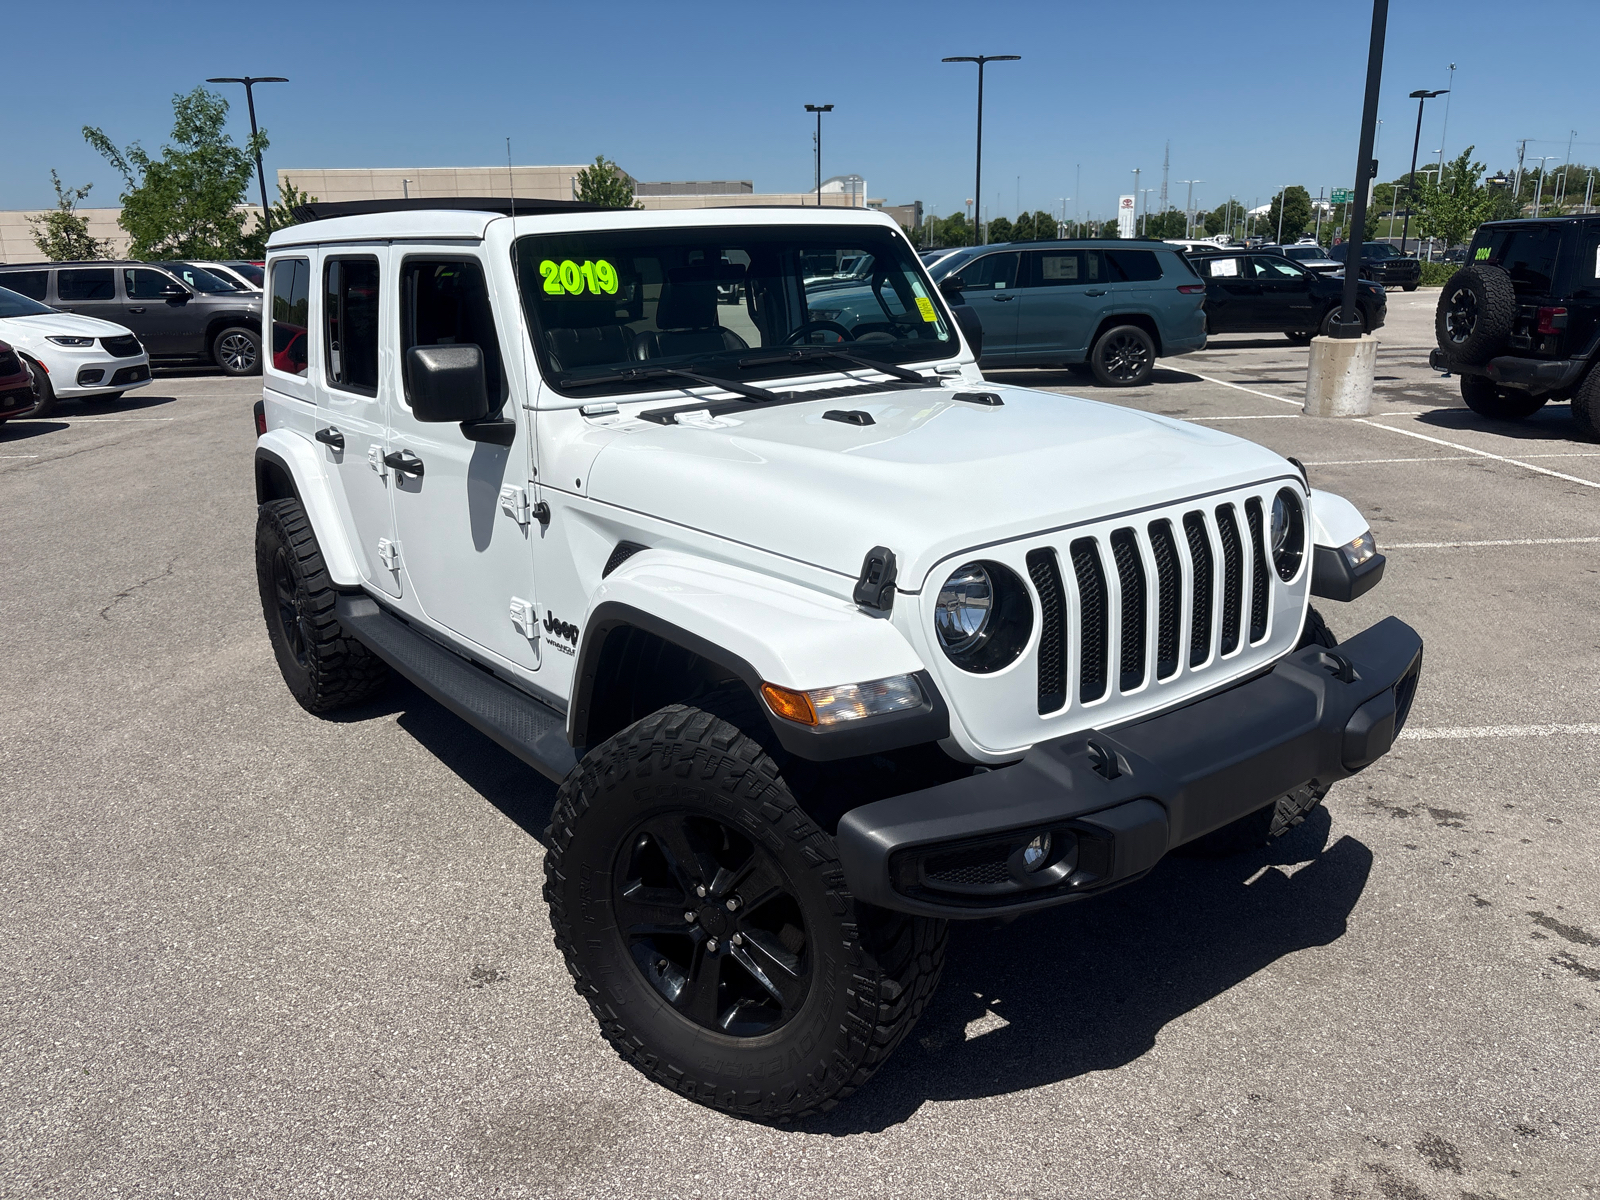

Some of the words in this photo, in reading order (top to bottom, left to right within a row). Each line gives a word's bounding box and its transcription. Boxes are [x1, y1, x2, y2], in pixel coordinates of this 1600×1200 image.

[1475, 247, 1492, 260] 2024
[539, 259, 619, 295] 2019
[543, 609, 579, 647] Jeep
[632, 782, 785, 857] COOPER
[698, 951, 836, 1080] DISCOVERER
